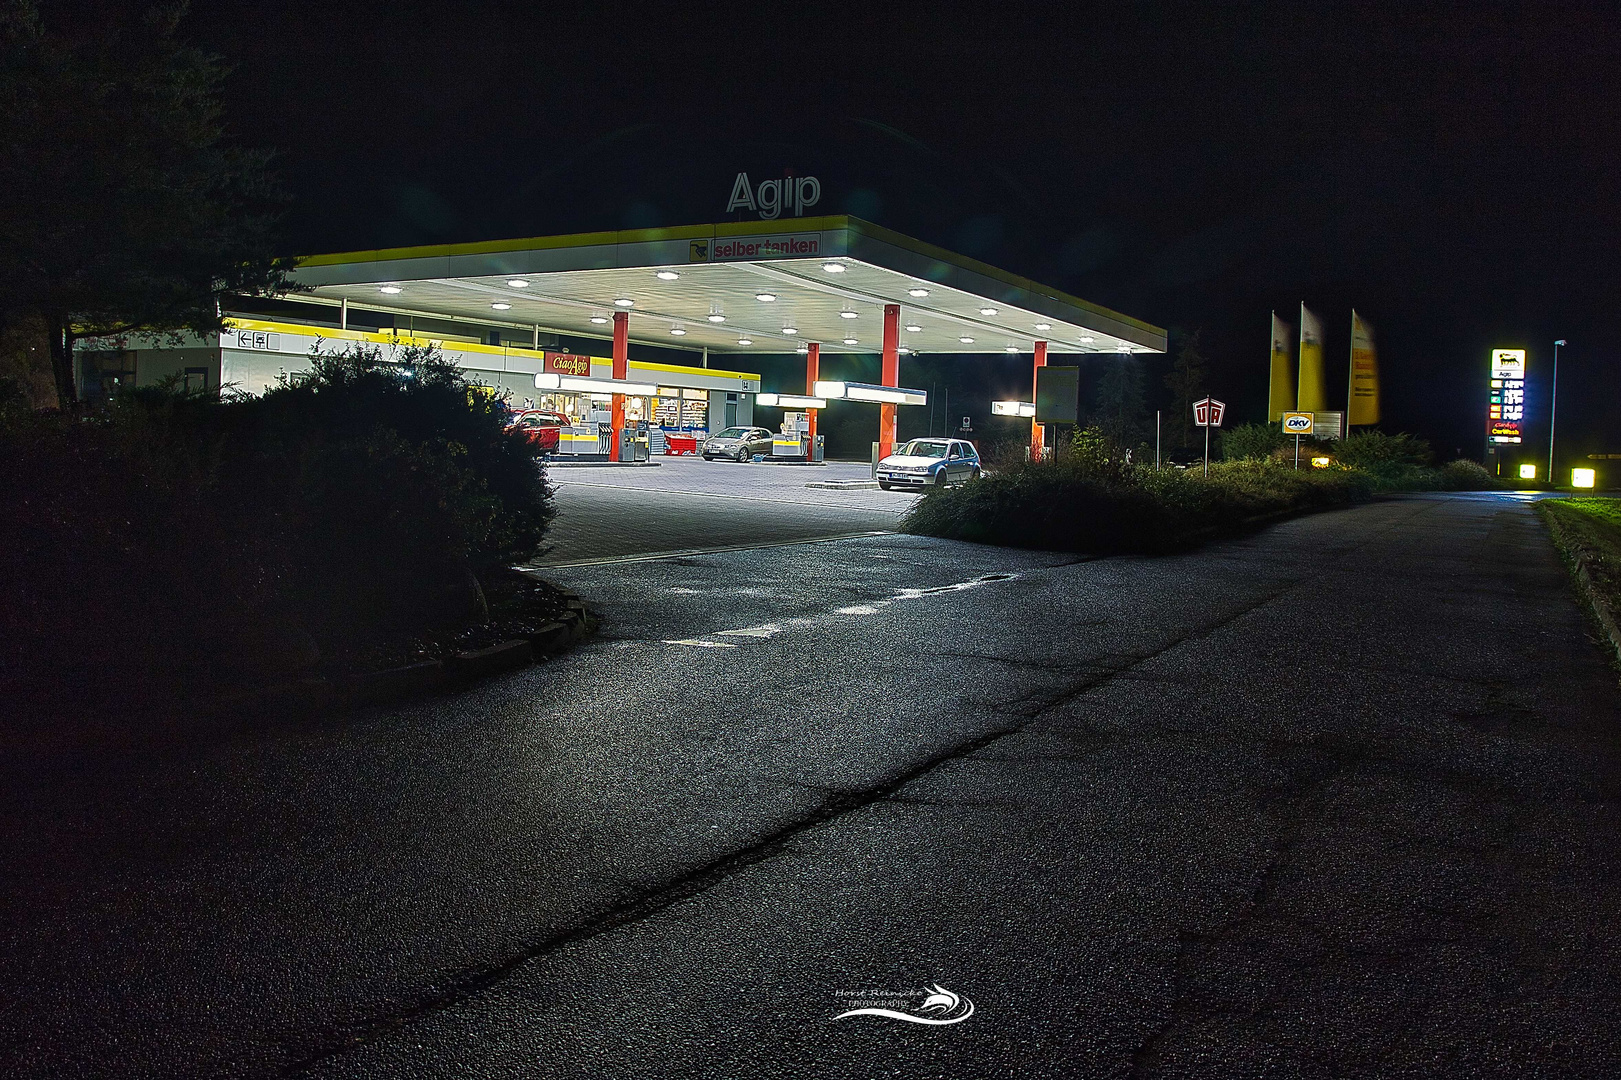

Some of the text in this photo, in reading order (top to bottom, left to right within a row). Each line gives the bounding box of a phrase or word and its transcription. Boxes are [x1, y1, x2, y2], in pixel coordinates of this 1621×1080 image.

[726, 172, 821, 220] Agip
[715, 238, 818, 257] selber tanken
[1287, 419, 1310, 427] DKV
